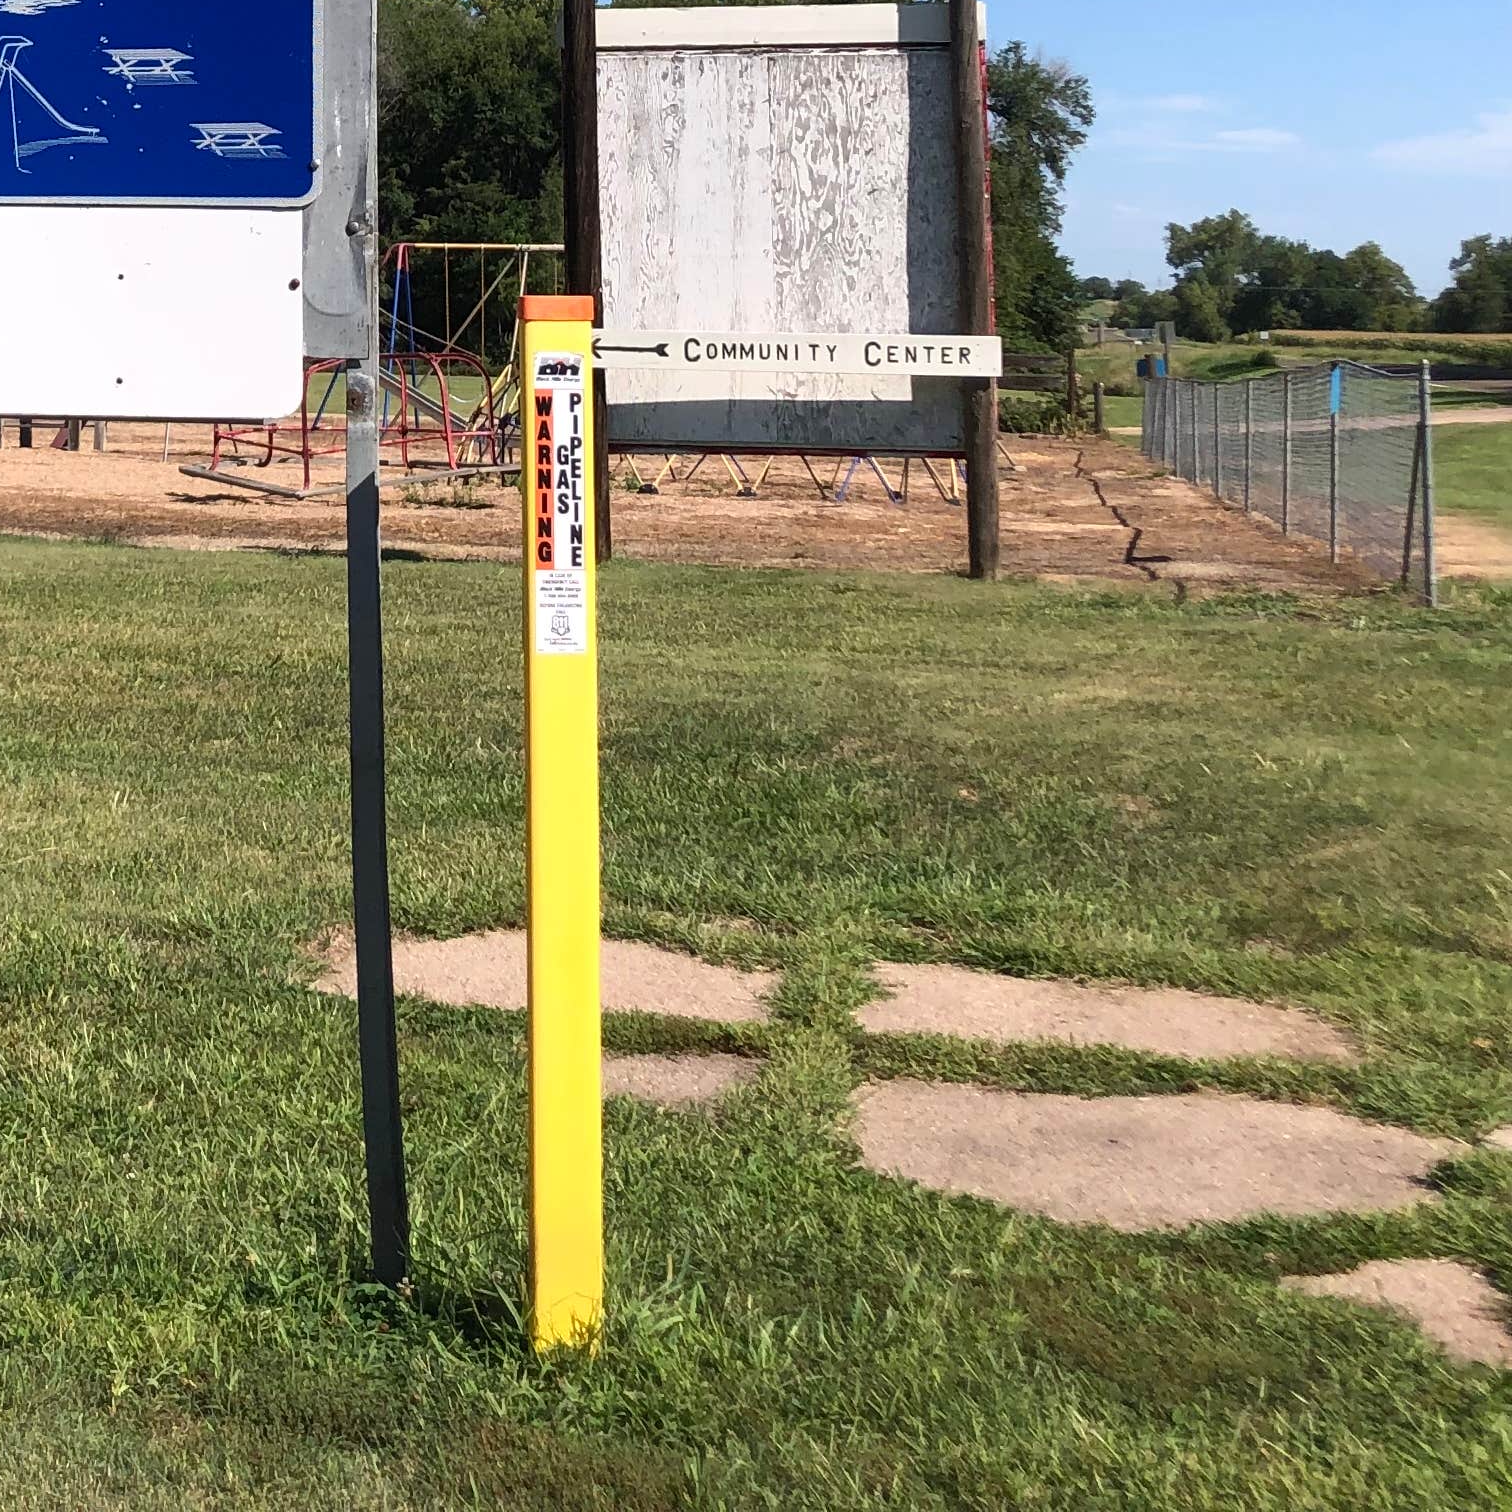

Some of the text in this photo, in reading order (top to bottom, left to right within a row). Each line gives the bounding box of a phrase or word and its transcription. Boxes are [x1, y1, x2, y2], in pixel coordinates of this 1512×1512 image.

[684, 338, 972, 367] COMMUNITY CENTER
[535, 396, 553, 563] WARNING
[556, 445, 570, 515] GAS
[569, 393, 583, 567] PIPELINE
